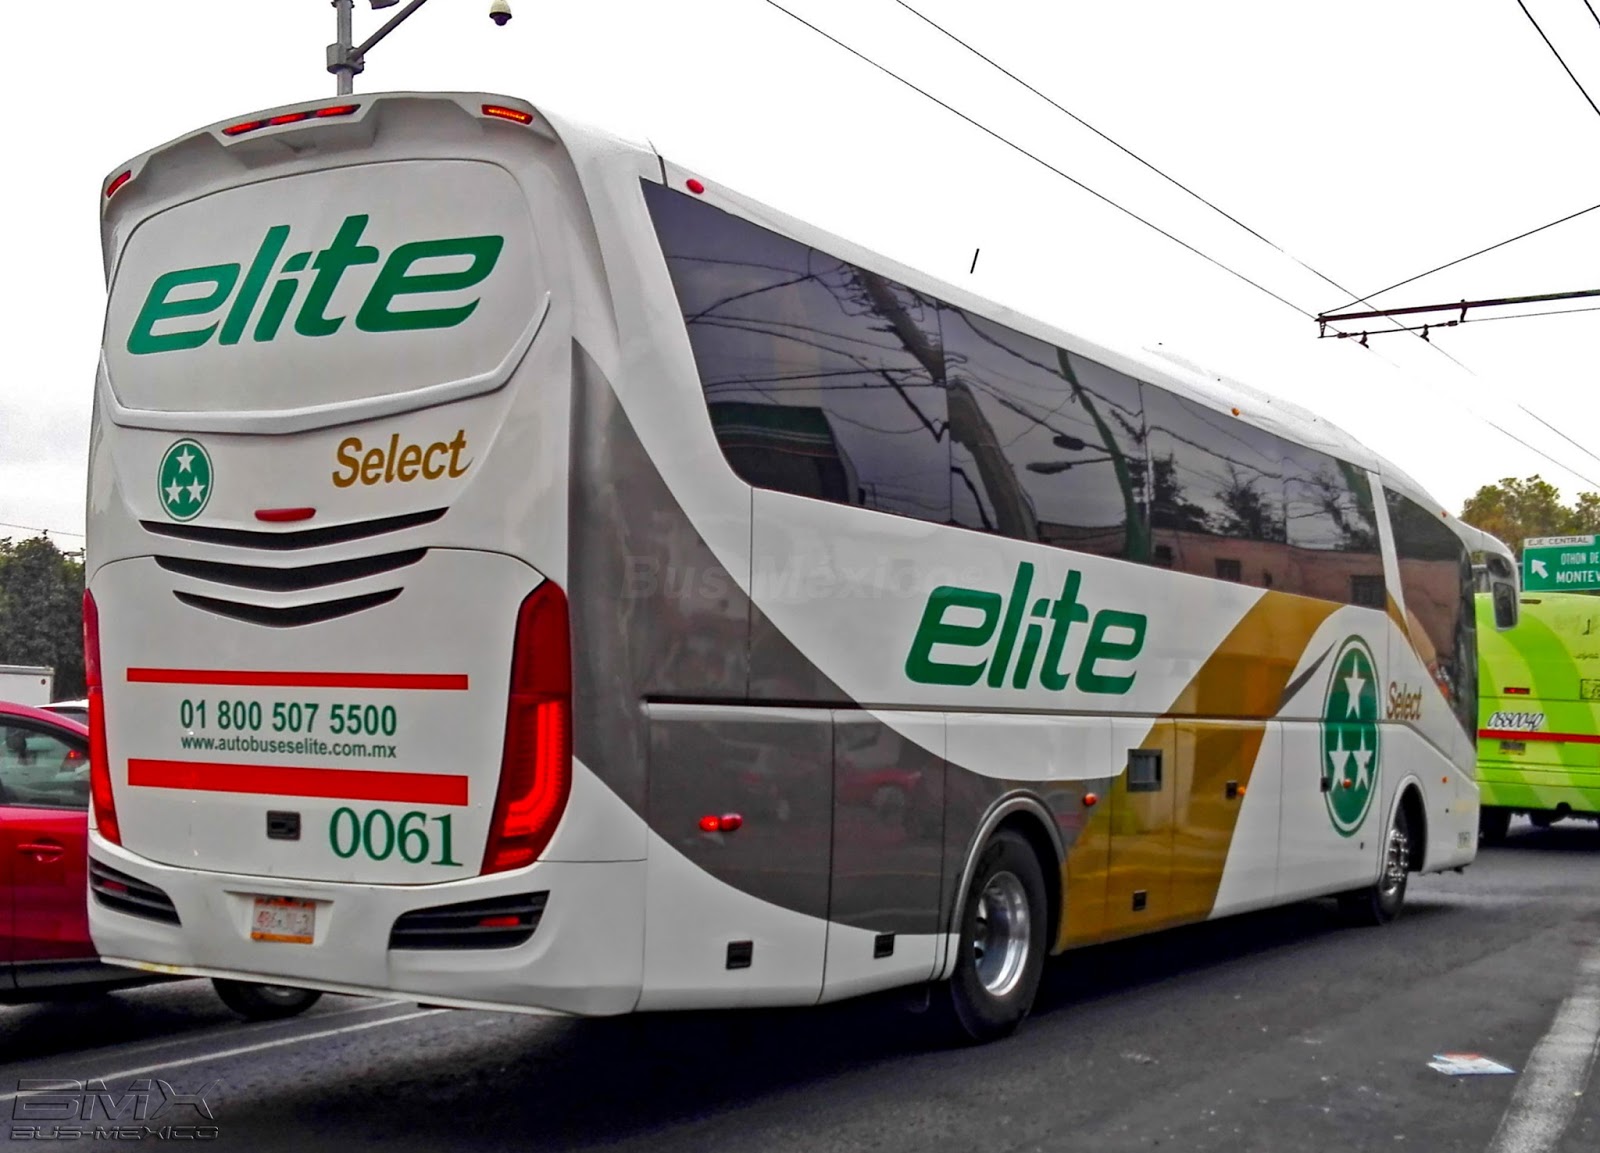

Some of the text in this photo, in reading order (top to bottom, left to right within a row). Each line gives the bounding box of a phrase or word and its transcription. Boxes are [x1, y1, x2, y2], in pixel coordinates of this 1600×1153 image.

[127, 214, 504, 355] elite
[331, 429, 474, 487] Select
[1528, 536, 1588, 546] EJE CENTRAL
[905, 561, 1147, 695] elite
[181, 699, 397, 736] 01 800 507 5500
[1386, 681, 1422, 720] Select
[181, 736, 397, 758] www.autobuseselite.com.mx
[328, 806, 464, 867] 0061
